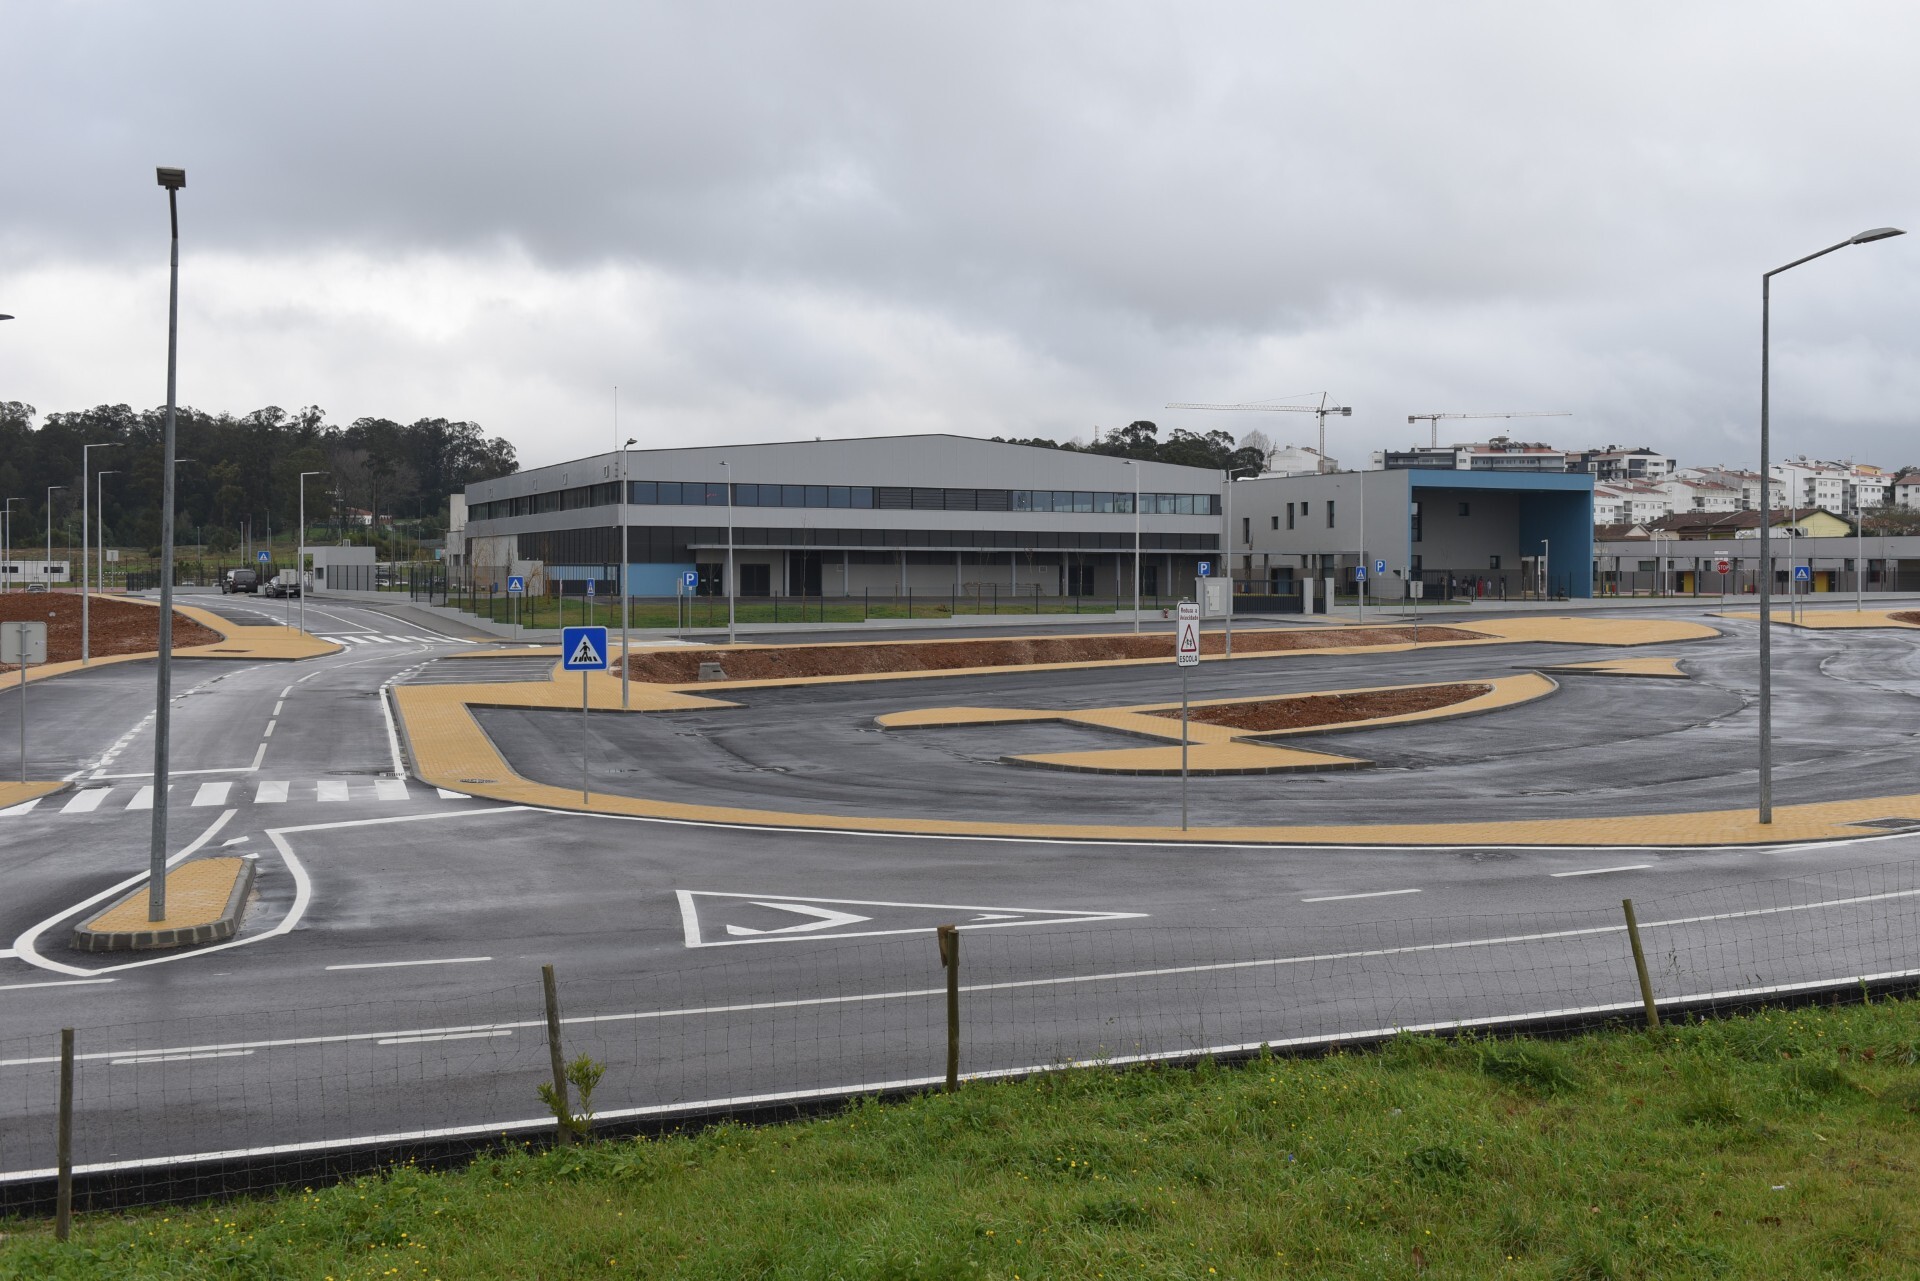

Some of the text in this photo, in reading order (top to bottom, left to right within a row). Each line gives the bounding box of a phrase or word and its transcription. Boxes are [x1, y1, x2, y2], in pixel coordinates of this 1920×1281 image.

[1200, 564, 1208, 574] P
[1378, 562, 1384, 572] P
[686, 574, 694, 584] P
